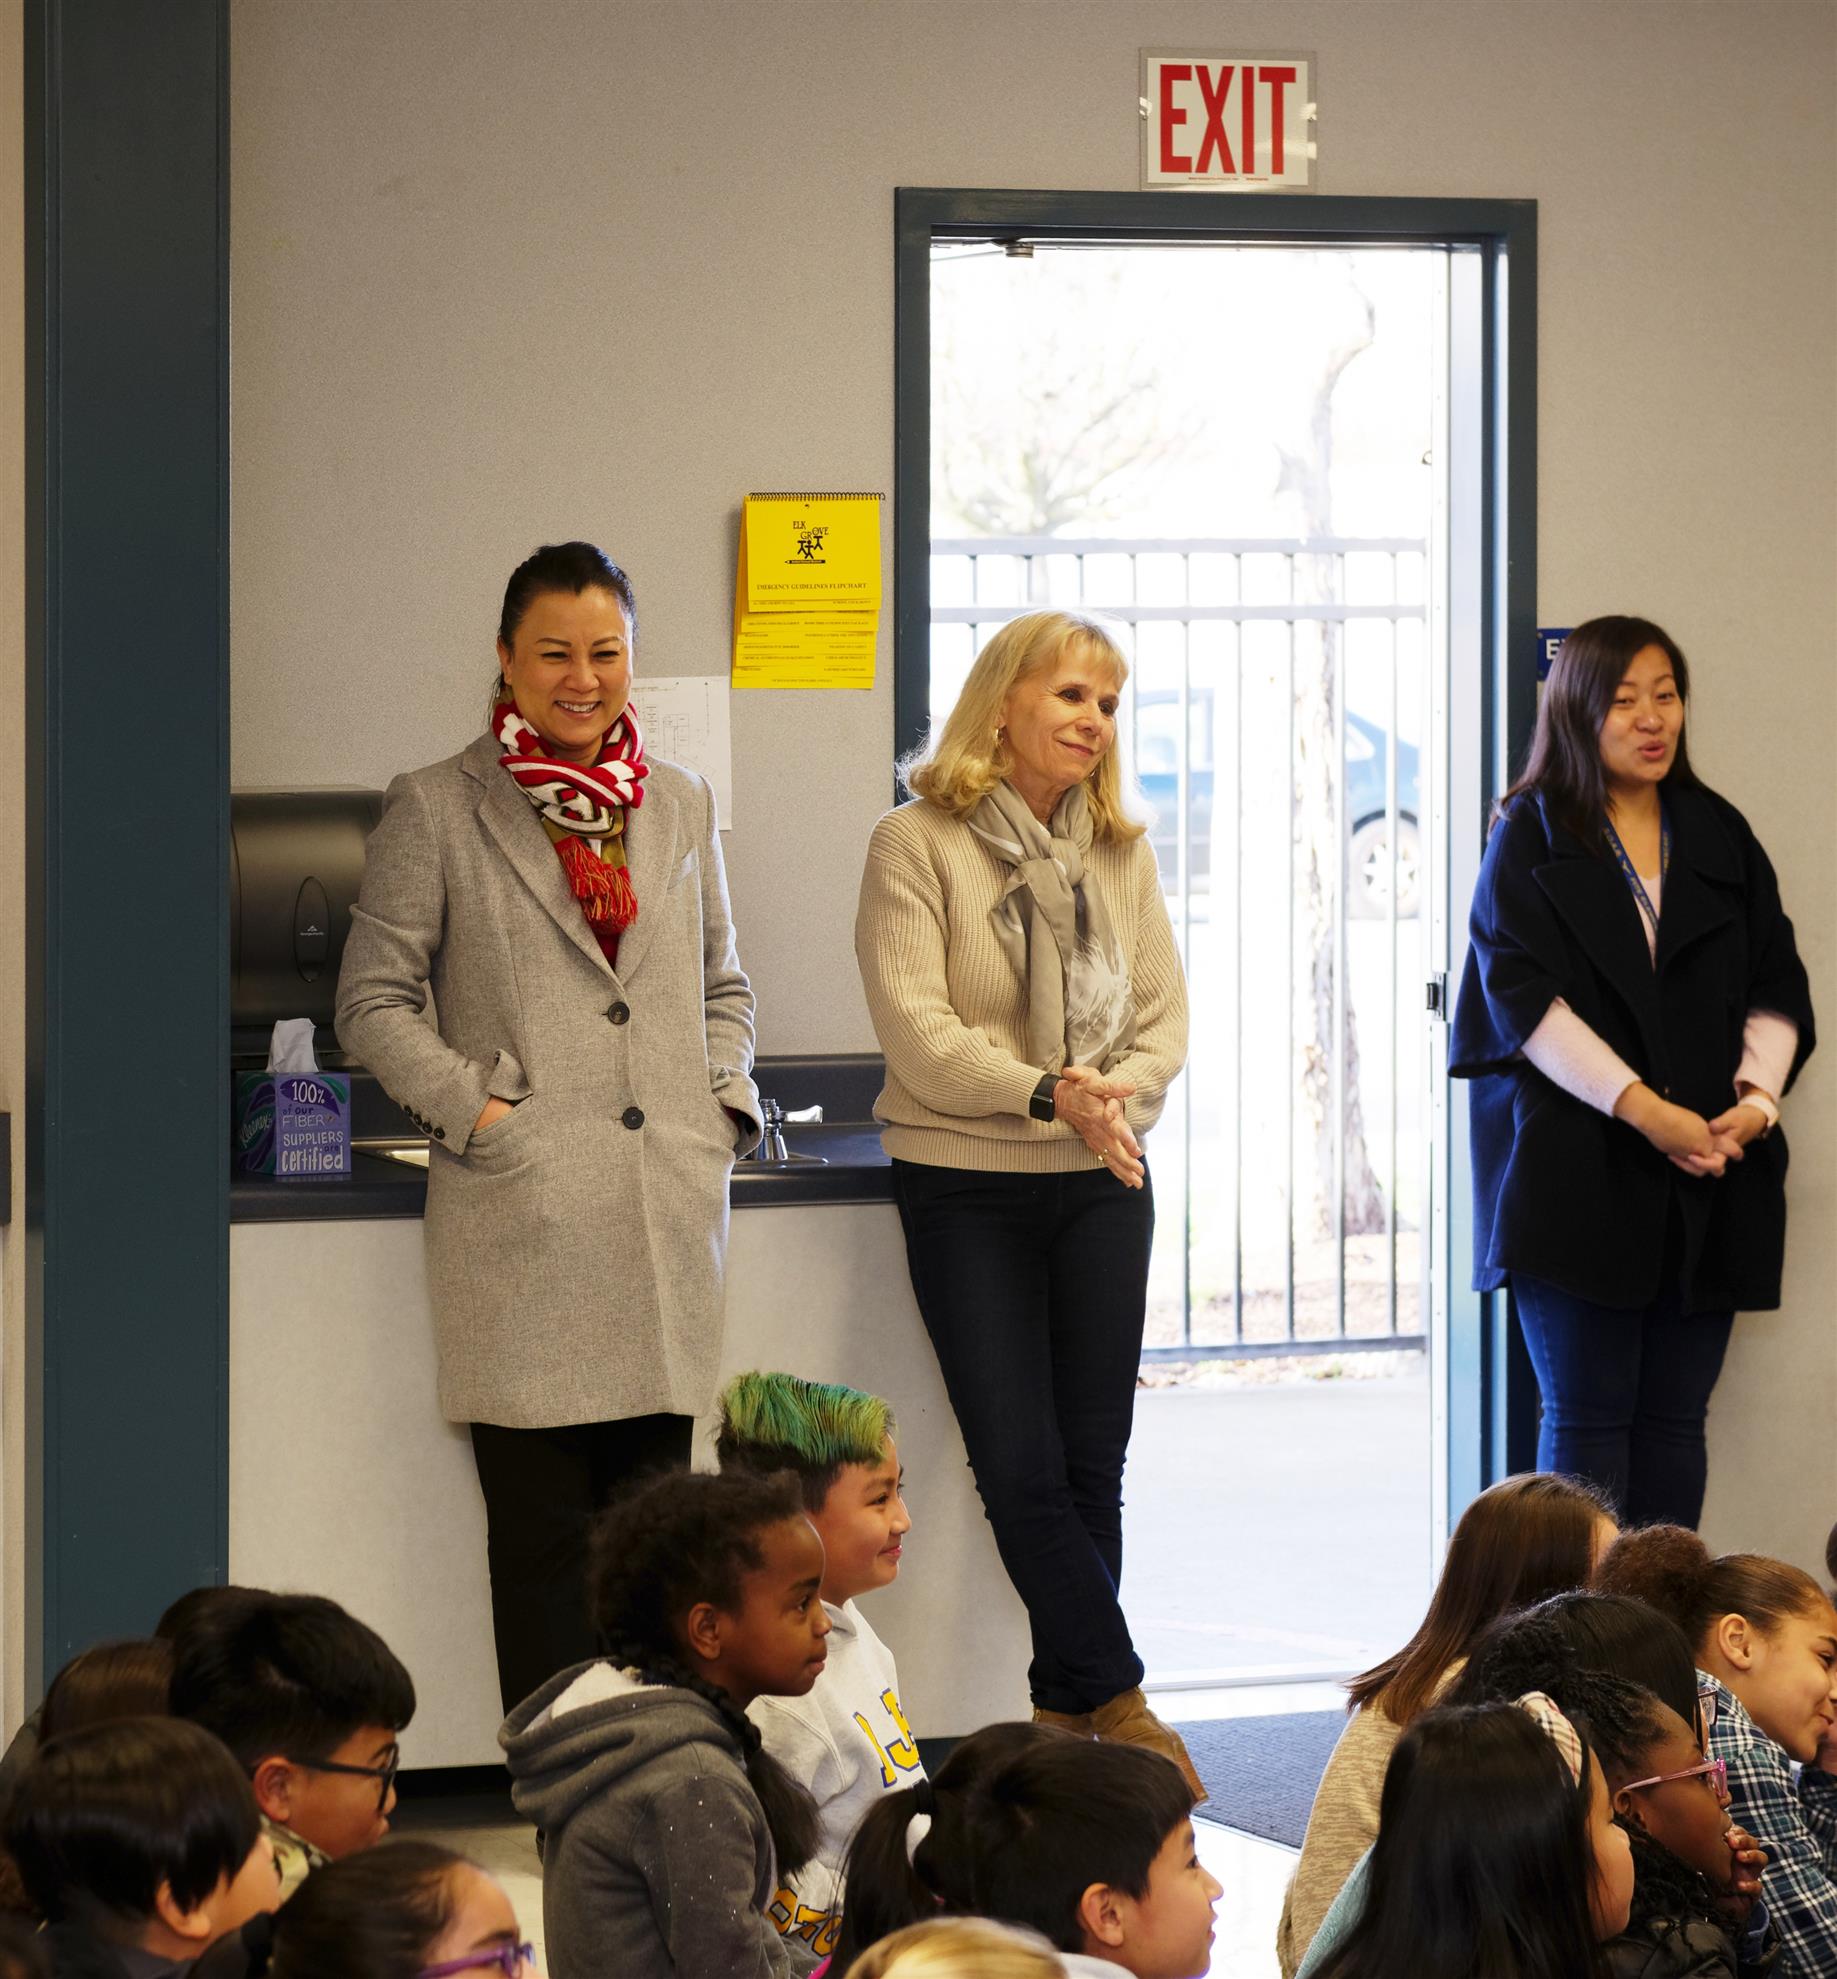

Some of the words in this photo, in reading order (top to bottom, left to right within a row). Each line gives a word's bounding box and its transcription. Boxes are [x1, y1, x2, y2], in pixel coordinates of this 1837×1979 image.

[1160, 64, 1296, 175] EXIT
[793, 520, 806, 530] ELK
[800, 527, 829, 540] GROVE
[291, 1080, 325, 1104] 100%
[282, 1104, 292, 1115] of
[294, 1106, 314, 1115] our
[282, 1114, 325, 1128] FIBER
[283, 1131, 344, 1147] SUPPLIERS
[281, 1145, 344, 1172] certified
